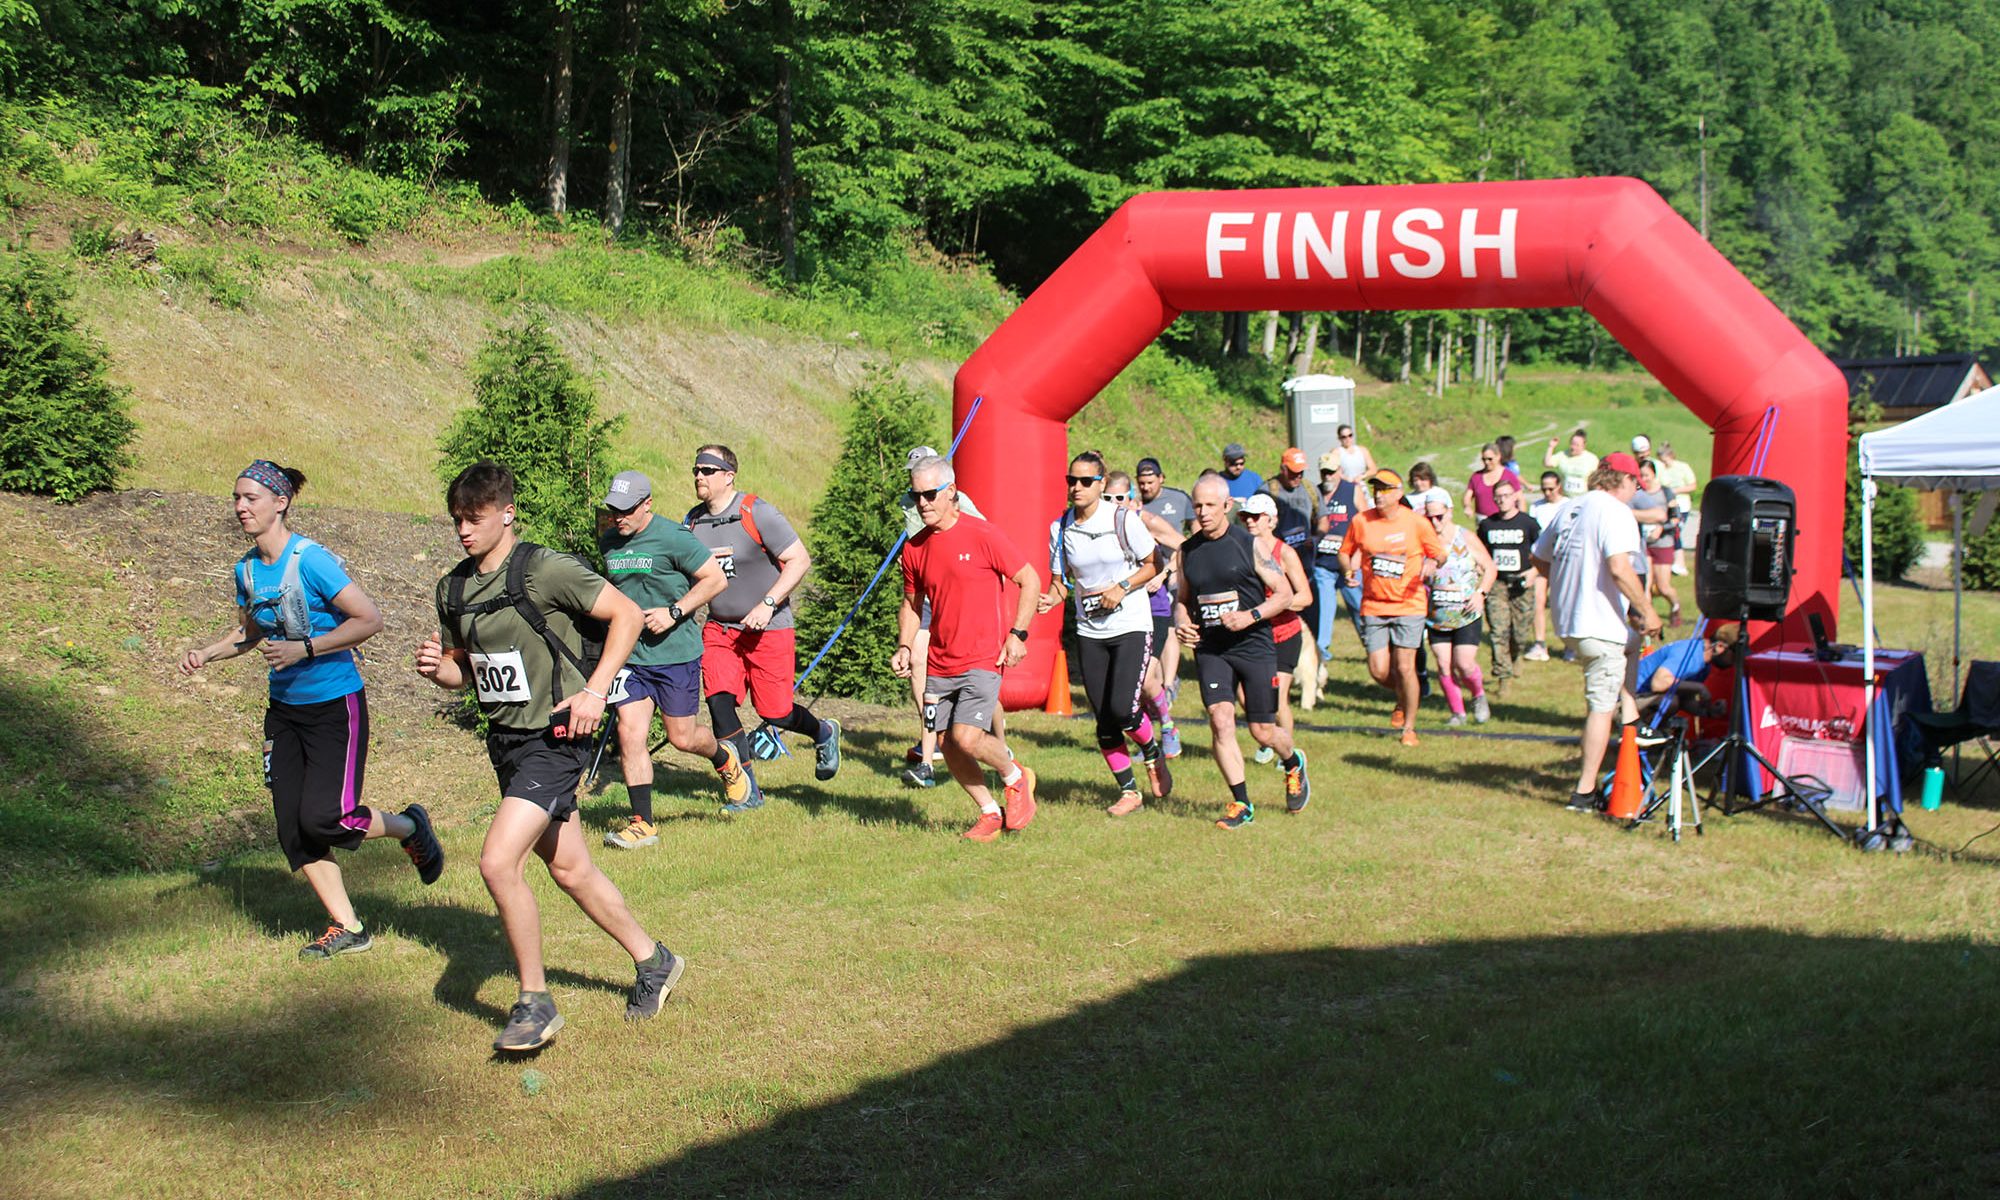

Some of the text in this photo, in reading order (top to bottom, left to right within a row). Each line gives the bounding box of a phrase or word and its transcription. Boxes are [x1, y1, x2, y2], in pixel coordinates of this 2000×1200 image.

[1206, 208, 1518, 279] FINISH
[1488, 529, 1524, 544] USMC
[1495, 555, 1517, 566] 305
[297, 599, 307, 631] NATHAN
[476, 665, 520, 693] 302
